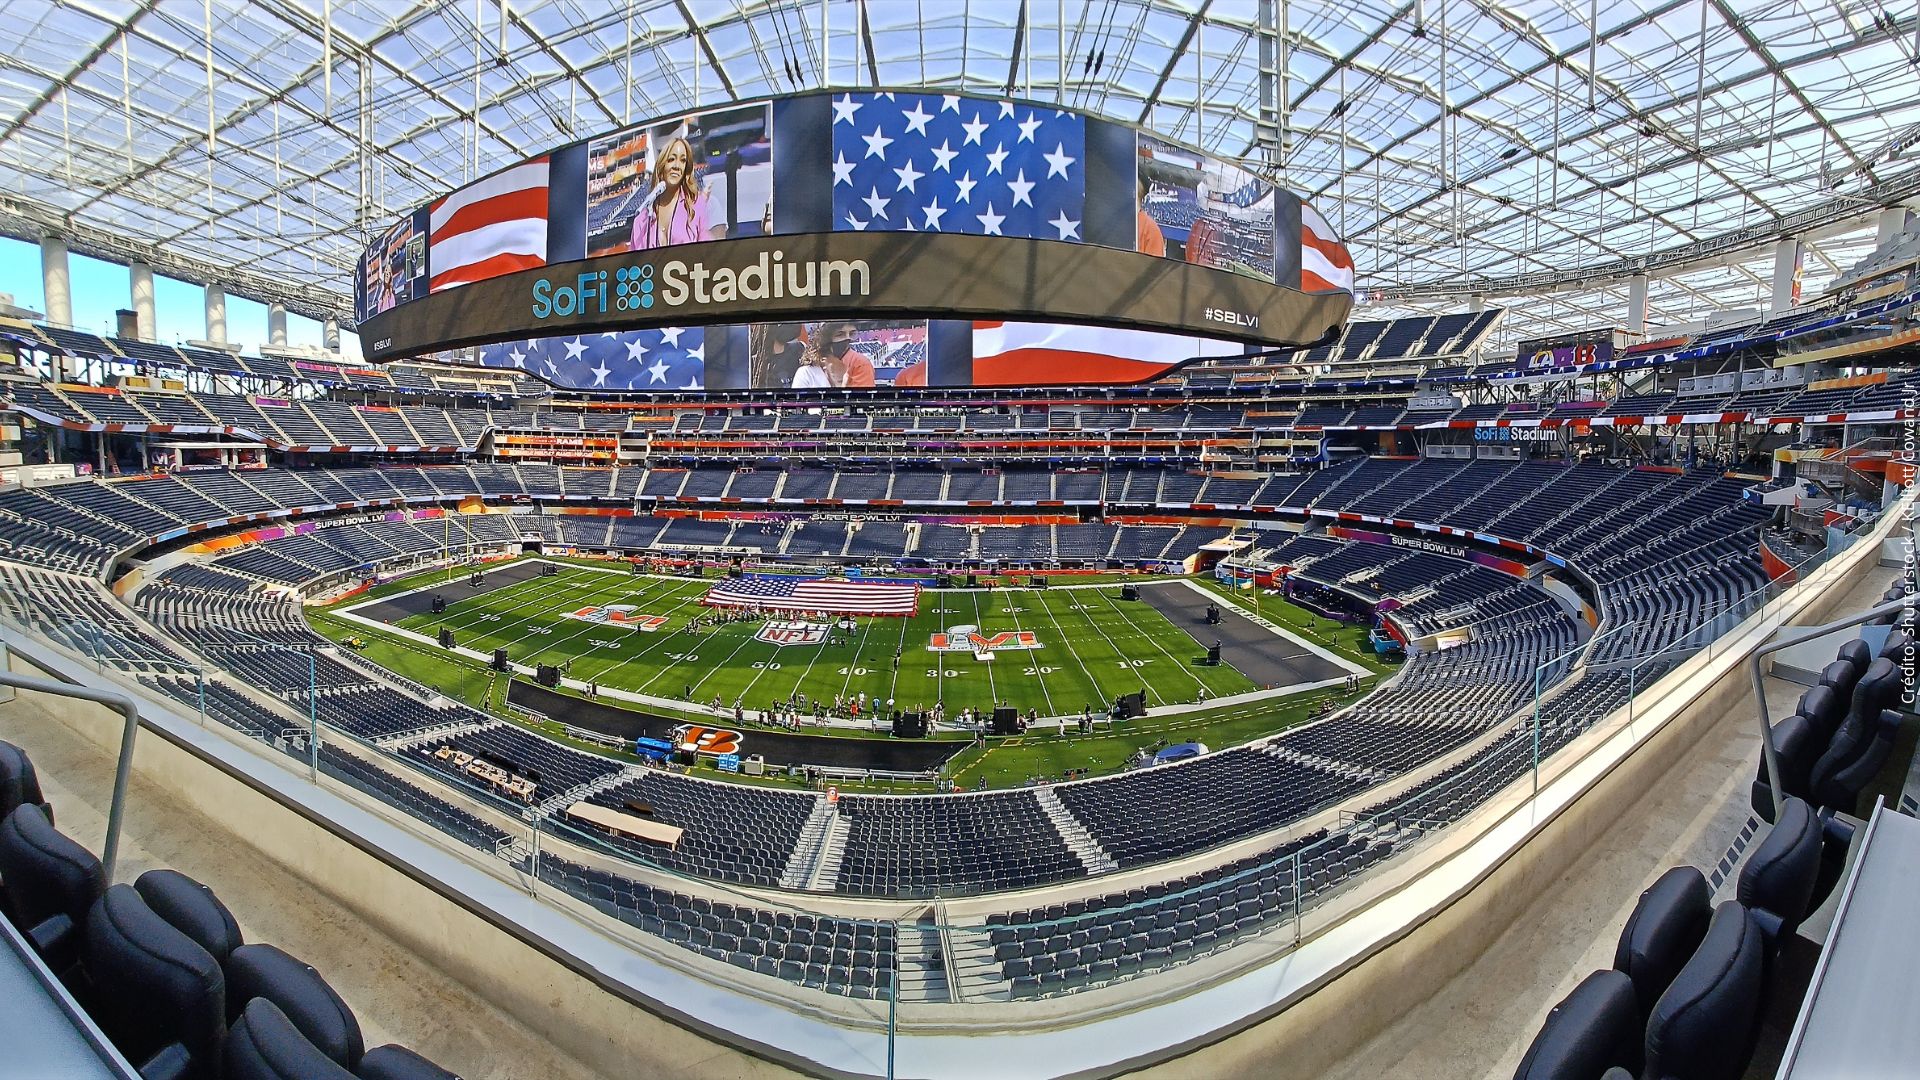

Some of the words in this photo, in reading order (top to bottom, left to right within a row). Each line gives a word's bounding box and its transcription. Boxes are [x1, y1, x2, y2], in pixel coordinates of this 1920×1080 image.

[532, 270, 607, 319] SoFi
[662, 250, 870, 306] Stadium
[1205, 307, 1259, 328] #SBLVI
[1474, 427, 1498, 441] SoFi
[1510, 426, 1557, 441] Stadium
[315, 519, 345, 530] SUPER
[346, 516, 371, 525] BOWL
[372, 514, 385, 522] LVI
[812, 513, 849, 521] SUPER
[850, 514, 884, 522] BOWL
[1391, 537, 1422, 549] SUPER
[1423, 542, 1450, 554] BOWL
[1451, 547, 1465, 558] LVI
[763, 629, 817, 642] NFL
[751, 661, 782, 671] 50
[837, 666, 868, 676] 40
[1022, 666, 1053, 676] 20
[926, 669, 959, 678] 30
